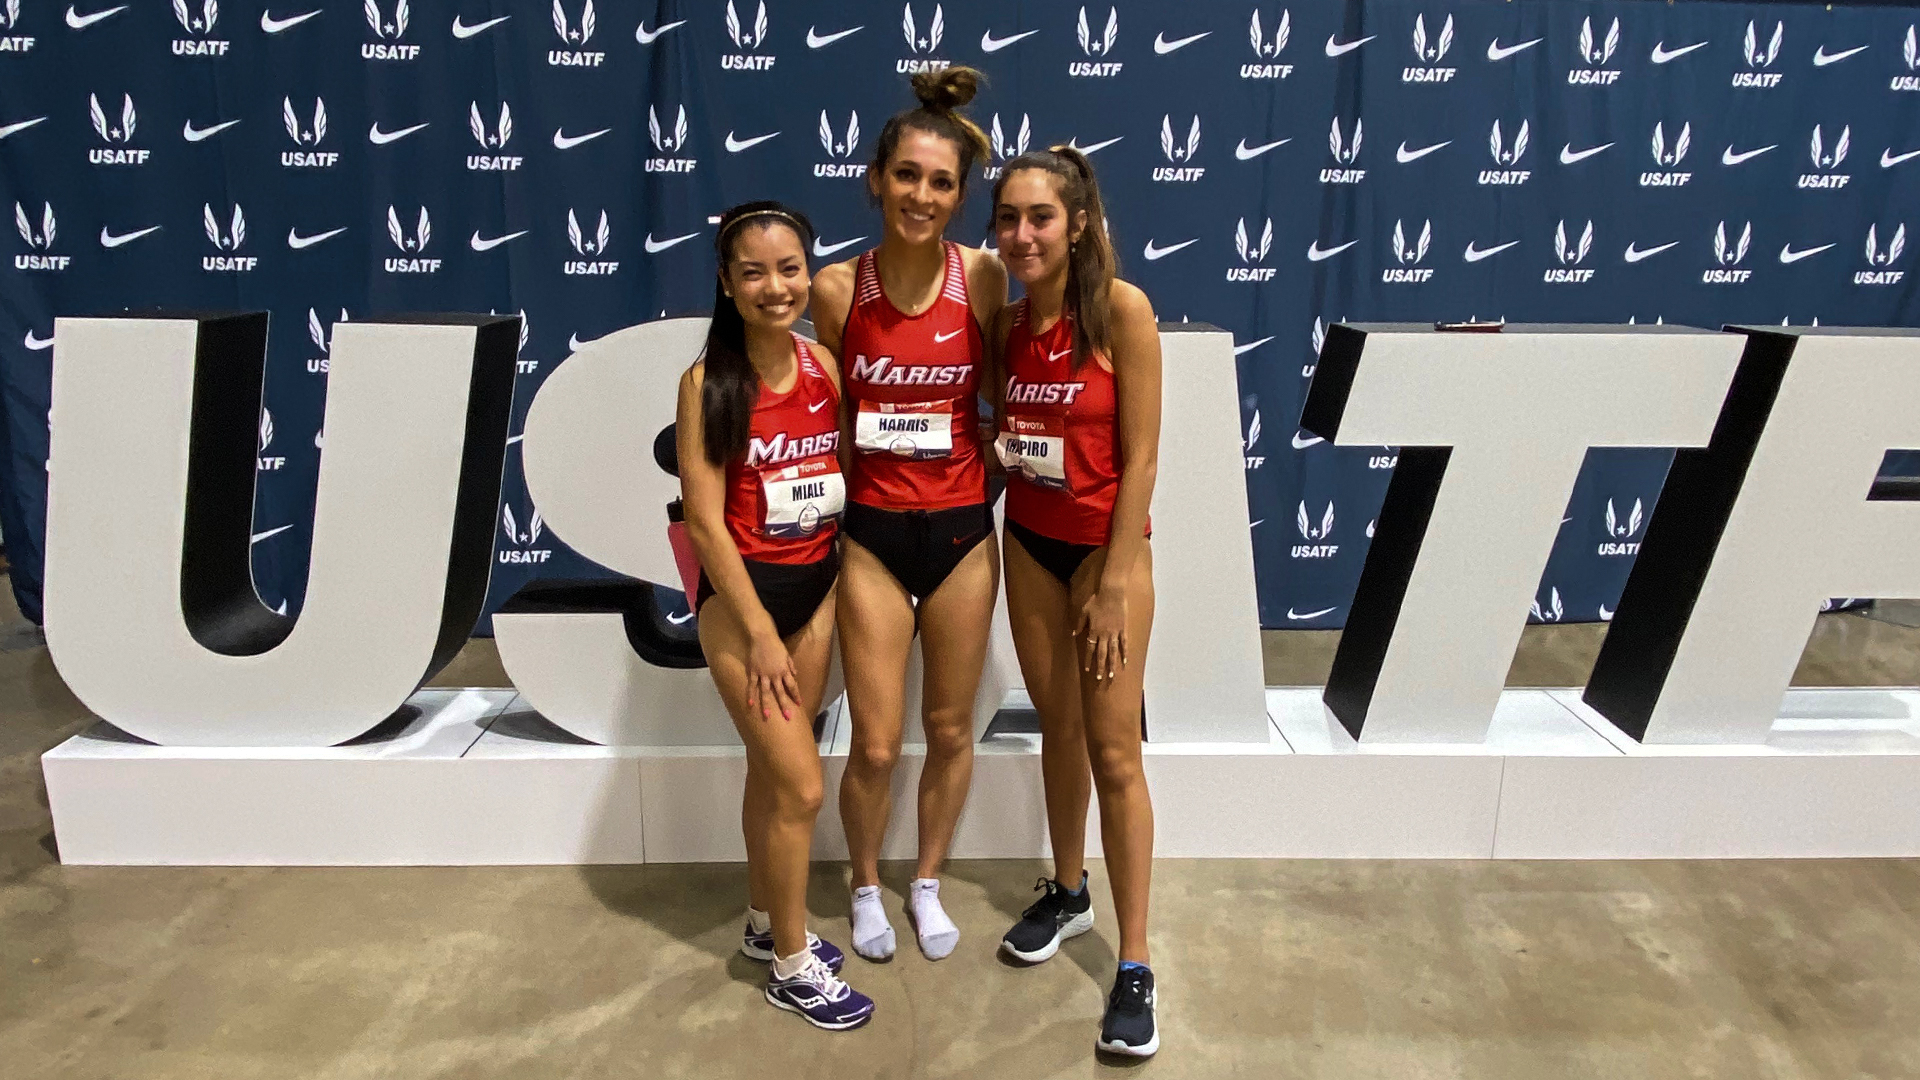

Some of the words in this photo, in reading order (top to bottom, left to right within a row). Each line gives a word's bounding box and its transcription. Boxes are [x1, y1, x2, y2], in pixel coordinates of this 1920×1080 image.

[0, 36, 35, 51] ATF
[171, 40, 230, 55] USATF
[361, 44, 421, 59] USATF
[547, 51, 606, 66] USATF
[721, 55, 776, 70] USATF
[1068, 62, 1123, 76] USATF
[1239, 64, 1294, 78] USATF
[1401, 68, 1457, 82] USATF
[1567, 70, 1622, 84] USATF
[1731, 73, 1783, 87] USATF
[1890, 76, 1920, 91] USA
[88, 149, 151, 164] USATF
[281, 152, 339, 166] USATF
[466, 156, 524, 170] USATF
[644, 159, 697, 172] USATF
[813, 164, 868, 177] USATF
[1152, 168, 1206, 181] USATF
[1318, 169, 1366, 183] USATF
[1477, 171, 1532, 184] USATF
[1639, 173, 1692, 186] USATF
[1797, 174, 1851, 188] USATF
[14, 255, 71, 270] USATF
[202, 257, 258, 271] USATF
[384, 259, 442, 272] USATF
[563, 261, 620, 274] USATF
[1225, 268, 1277, 281] USATF
[1382, 269, 1434, 282] USATF
[1543, 269, 1596, 282] USATF
[1702, 270, 1752, 283] USATF
[1853, 271, 1905, 284] USATF
[850, 354, 974, 386] MARIST
[879, 417, 931, 433] HARRIS
[1016, 420, 1046, 431] TOYOTA
[743, 431, 840, 467] MARIST
[800, 461, 827, 473] TOYOTA
[1369, 456, 1398, 469] USA
[792, 481, 825, 502] MIALE
[499, 550, 552, 563] USATF
[1290, 546, 1339, 558] USATF
